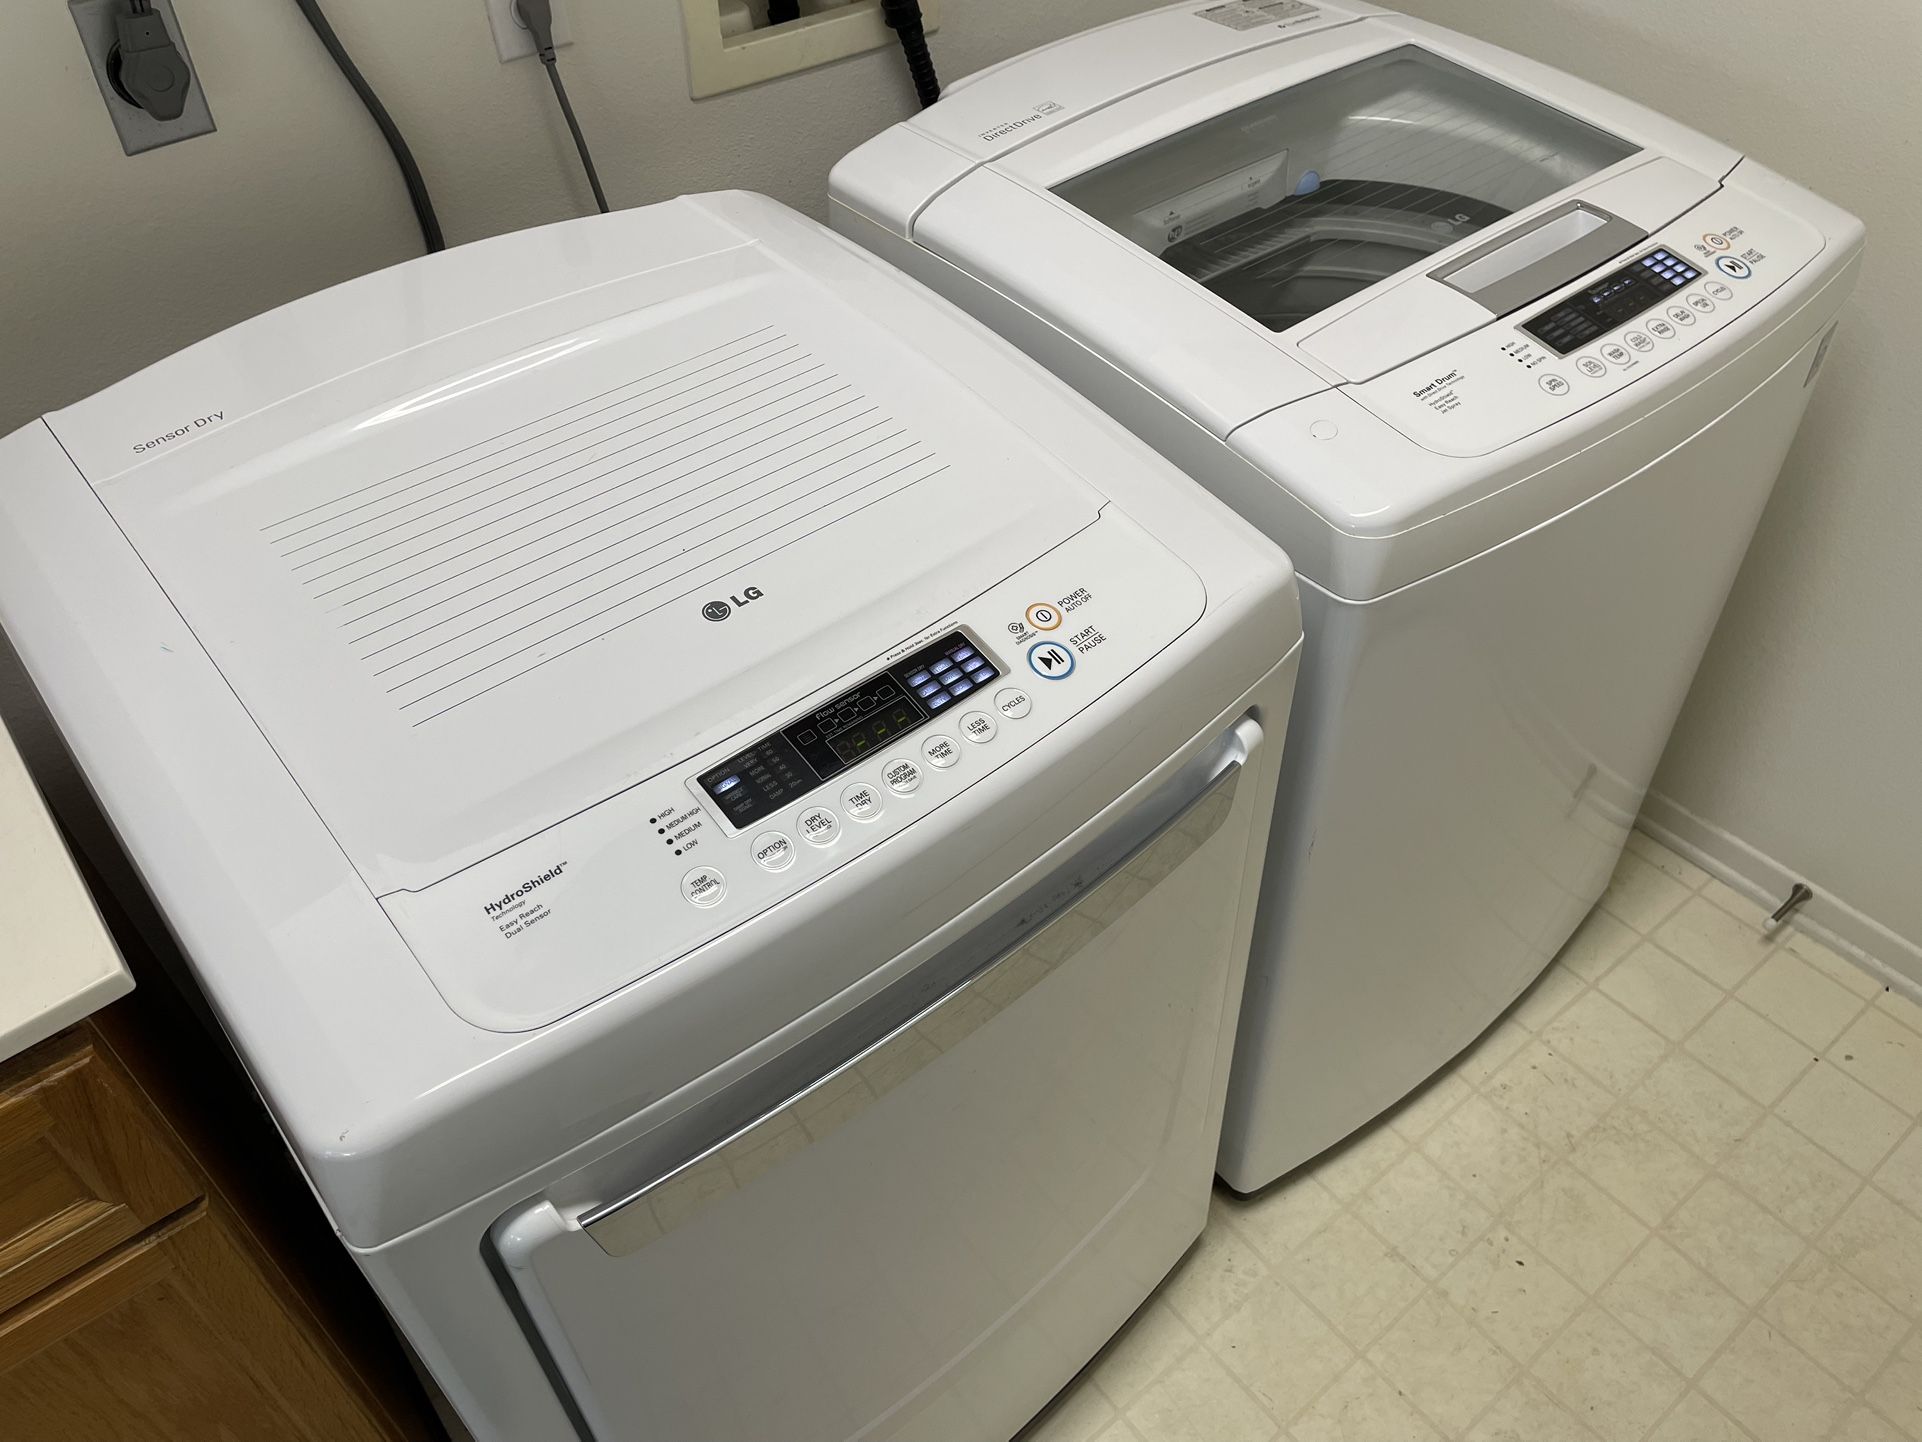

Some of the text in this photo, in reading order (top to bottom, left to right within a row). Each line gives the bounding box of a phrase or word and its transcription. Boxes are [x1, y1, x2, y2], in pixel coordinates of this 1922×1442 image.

[983, 113, 1042, 142] DirectDrive
[1448, 213, 1470, 226] LG
[1740, 248, 1756, 260] START
[1748, 252, 1766, 265] PAUSE
[1651, 322, 1666, 332] EXTRA
[1413, 382, 1438, 398] Smart
[132, 410, 224, 454] Sensor Dry
[729, 586, 764, 608] LG
[1057, 587, 1088, 608] POWER
[1064, 593, 1093, 613] AUTO OFF
[1069, 625, 1097, 646] START
[1078, 633, 1107, 654] PAUSE
[834, 691, 861, 710] sensor
[1001, 695, 1026, 712] CYCLES
[966, 717, 986, 732] LESS
[971, 723, 991, 737] TIME
[927, 740, 950, 757] MORE
[933, 747, 954, 760] TIME
[707, 767, 731, 783] OPTION
[886, 762, 910, 780] CUSTOM
[889, 767, 917, 787] PROGRAM
[848, 789, 871, 806] TIME
[657, 807, 675, 820] HIGH
[665, 806, 702, 831] MEDIUM HIGH
[804, 812, 823, 828] DRY
[674, 821, 702, 840] MEDIUM
[682, 838, 699, 852] LOW
[757, 839, 787, 860] OPTION
[690, 878, 721, 898] CONTROL
[490, 899, 527, 922] Technology
[498, 903, 544, 933] Easy Reach
[504, 908, 552, 940] Dual Sensor
